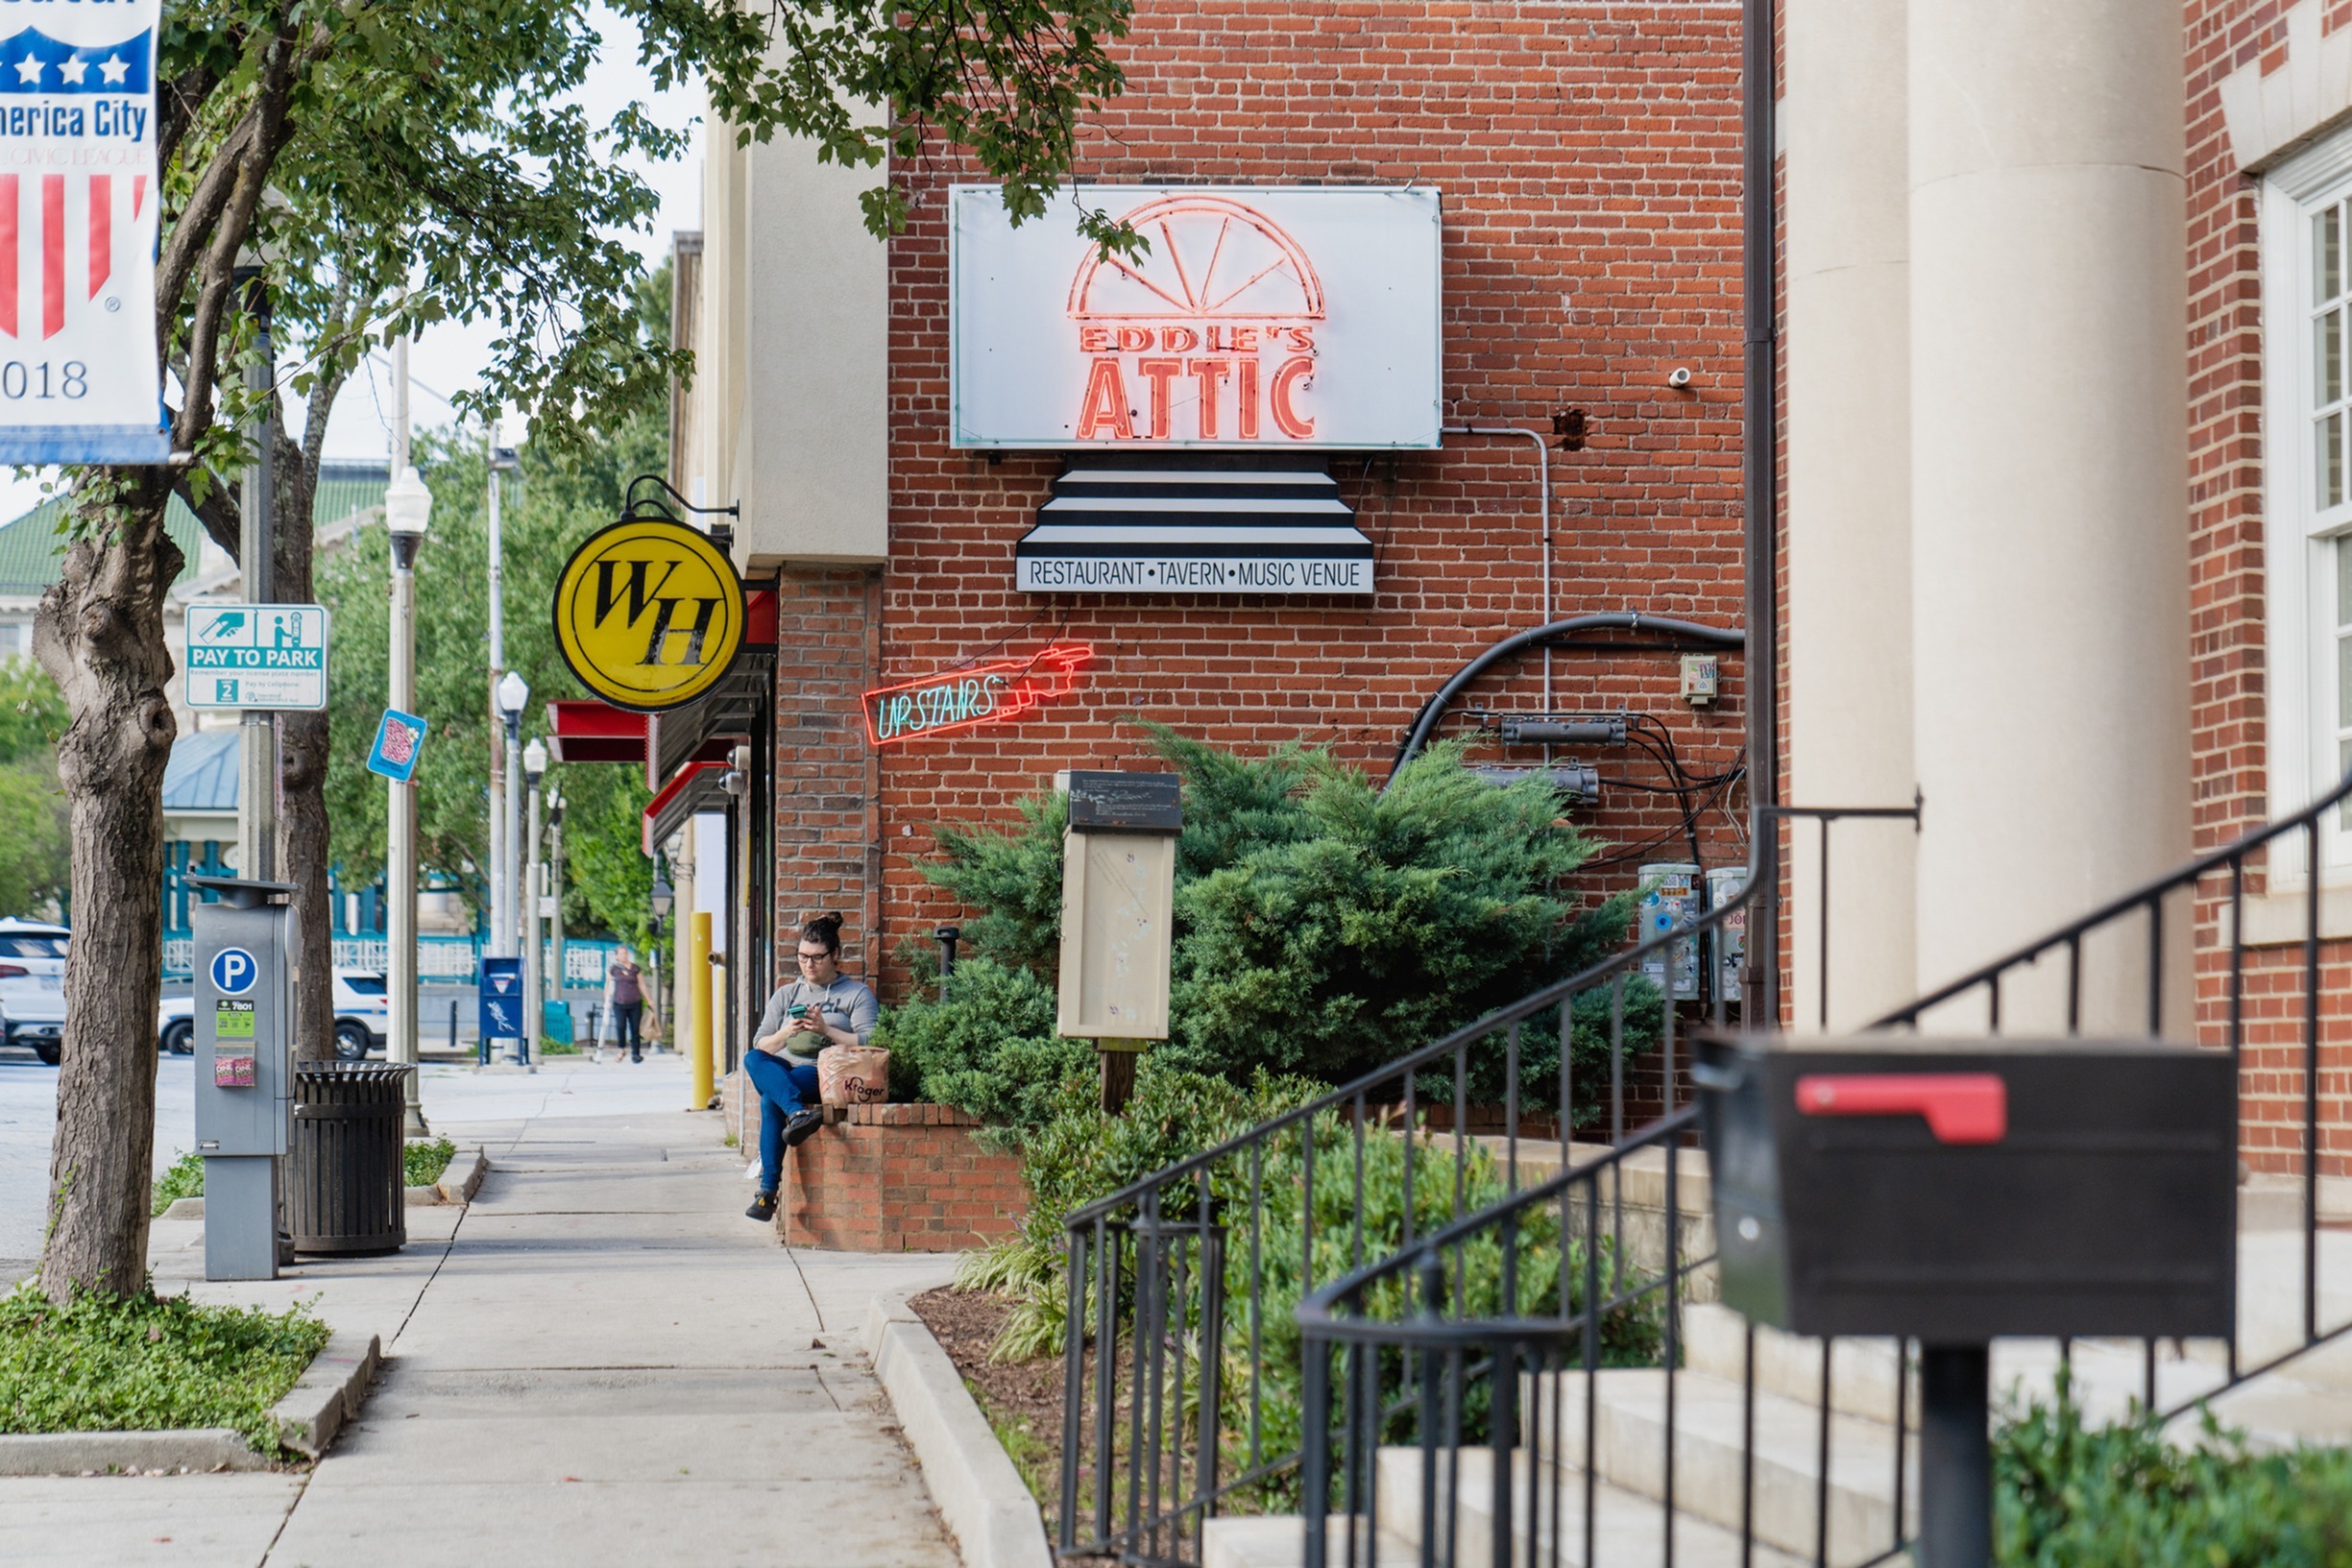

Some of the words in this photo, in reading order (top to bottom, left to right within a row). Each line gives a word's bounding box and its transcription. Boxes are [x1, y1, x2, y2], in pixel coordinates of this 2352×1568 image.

[95, 100, 147, 142] City
[10, 147, 67, 165] CIVIC
[72, 147, 148, 165] LEAGUE
[1079, 325, 1315, 352] EDDIE'S
[1076, 355, 1316, 441] ATTIC
[1030, 560, 1145, 586] RESTAURANT
[1156, 561, 1225, 587] TAVERN
[1239, 562, 1295, 587] MUSIC
[1300, 562, 1360, 587] VENUE
[594, 560, 725, 666] WH
[192, 649, 230, 664] PAY
[233, 649, 260, 665] TO
[266, 649, 318, 667] PARK
[271, 669, 289, 678] plate
[222, 684, 232, 698] 2
[878, 674, 1000, 739] UPSTAIRS
[225, 954, 247, 988] P
[232, 1001, 253, 1011] 7801
[844, 1076, 885, 1102] Kroger
